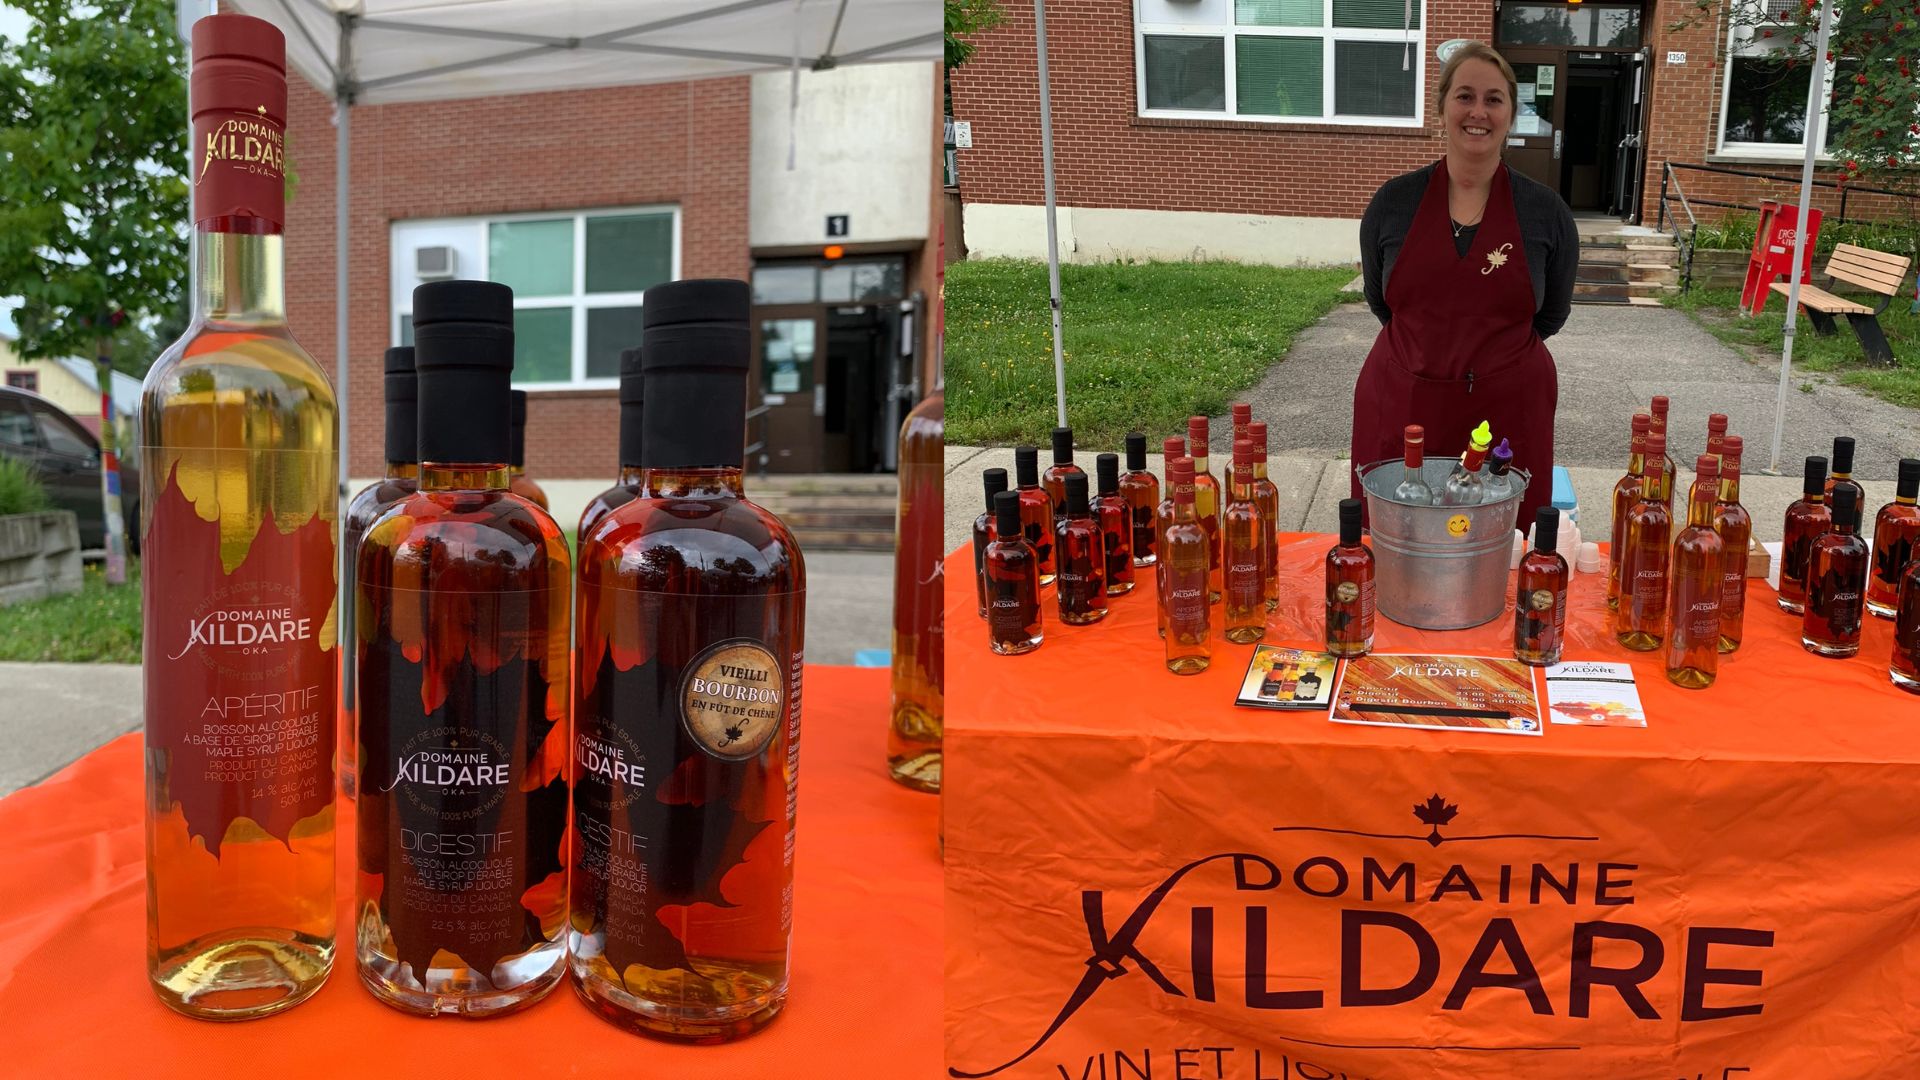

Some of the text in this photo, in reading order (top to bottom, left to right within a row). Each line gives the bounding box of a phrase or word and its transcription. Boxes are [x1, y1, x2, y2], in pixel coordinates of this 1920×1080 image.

[1669, 53, 1685, 62] 1350
[229, 120, 282, 147] DOMAINE
[250, 165, 268, 177] OKA
[217, 608, 291, 621] DOMAINE
[180, 613, 311, 652] KILDARE
[242, 647, 268, 655] OKA
[720, 664, 768, 682] VIEILLI
[1388, 665, 1481, 679] KILDARE
[1561, 666, 1616, 674] KILDARE
[692, 678, 780, 704] BOURBON
[201, 685, 319, 718] APÉRITIF
[691, 699, 707, 710] EN
[732, 707, 746, 716] DE
[747, 708, 776, 719] CHÊNE
[1356, 696, 1399, 704] Digestif
[1402, 698, 1448, 706] Bourbon
[203, 712, 319, 735] BOISSON ALCOOLIQUE
[183, 732, 191, 744] À
[193, 735, 221, 746] BASE
[224, 735, 240, 746] DE
[243, 733, 276, 745] SIROP
[206, 734, 318, 757] MAPLE SYRUP LIQUOR
[401, 737, 418, 756] FAIT
[417, 730, 431, 742] DE
[432, 726, 457, 738] 100%
[460, 727, 480, 738] PUR
[581, 734, 624, 760] DOMAINE
[209, 747, 318, 771] PRODUIT DU CANADA
[421, 752, 489, 764] DOMAINE
[204, 758, 318, 782] PRODUCT OF CANADA
[388, 754, 510, 789] KILDARE
[590, 773, 607, 786] OKA
[251, 788, 264, 799] 14
[267, 784, 277, 796] %
[280, 787, 317, 808] 500 mL
[441, 788, 466, 797] OKA
[420, 803, 440, 818] WITH
[441, 811, 462, 821] 100%
[462, 807, 485, 820] PURE
[483, 787, 507, 811] MAPLE
[400, 828, 513, 856] DIGESTIF
[580, 812, 648, 855] GESTIF
[402, 854, 513, 871] BOISSON ALCOOLIQUE
[593, 845, 648, 874] ALCOOLIQUE
[403, 875, 513, 892] MAPLE SYRUP LIQUOR
[417, 868, 432, 879] AU
[434, 870, 466, 881] SIROP
[1234, 855, 1639, 905] DOMAINE
[612, 877, 647, 894] LIQUOR
[406, 888, 512, 904] PRODUIT DU CANADA
[402, 898, 512, 914] PRODUCT OF CANADA
[456, 920, 466, 931] %
[469, 929, 511, 944] 500 mL
[1025, 870, 1775, 1045] KILDARE
[1057, 1048, 1150, 1080] VIN
[1175, 1047, 1235, 1080] ET
